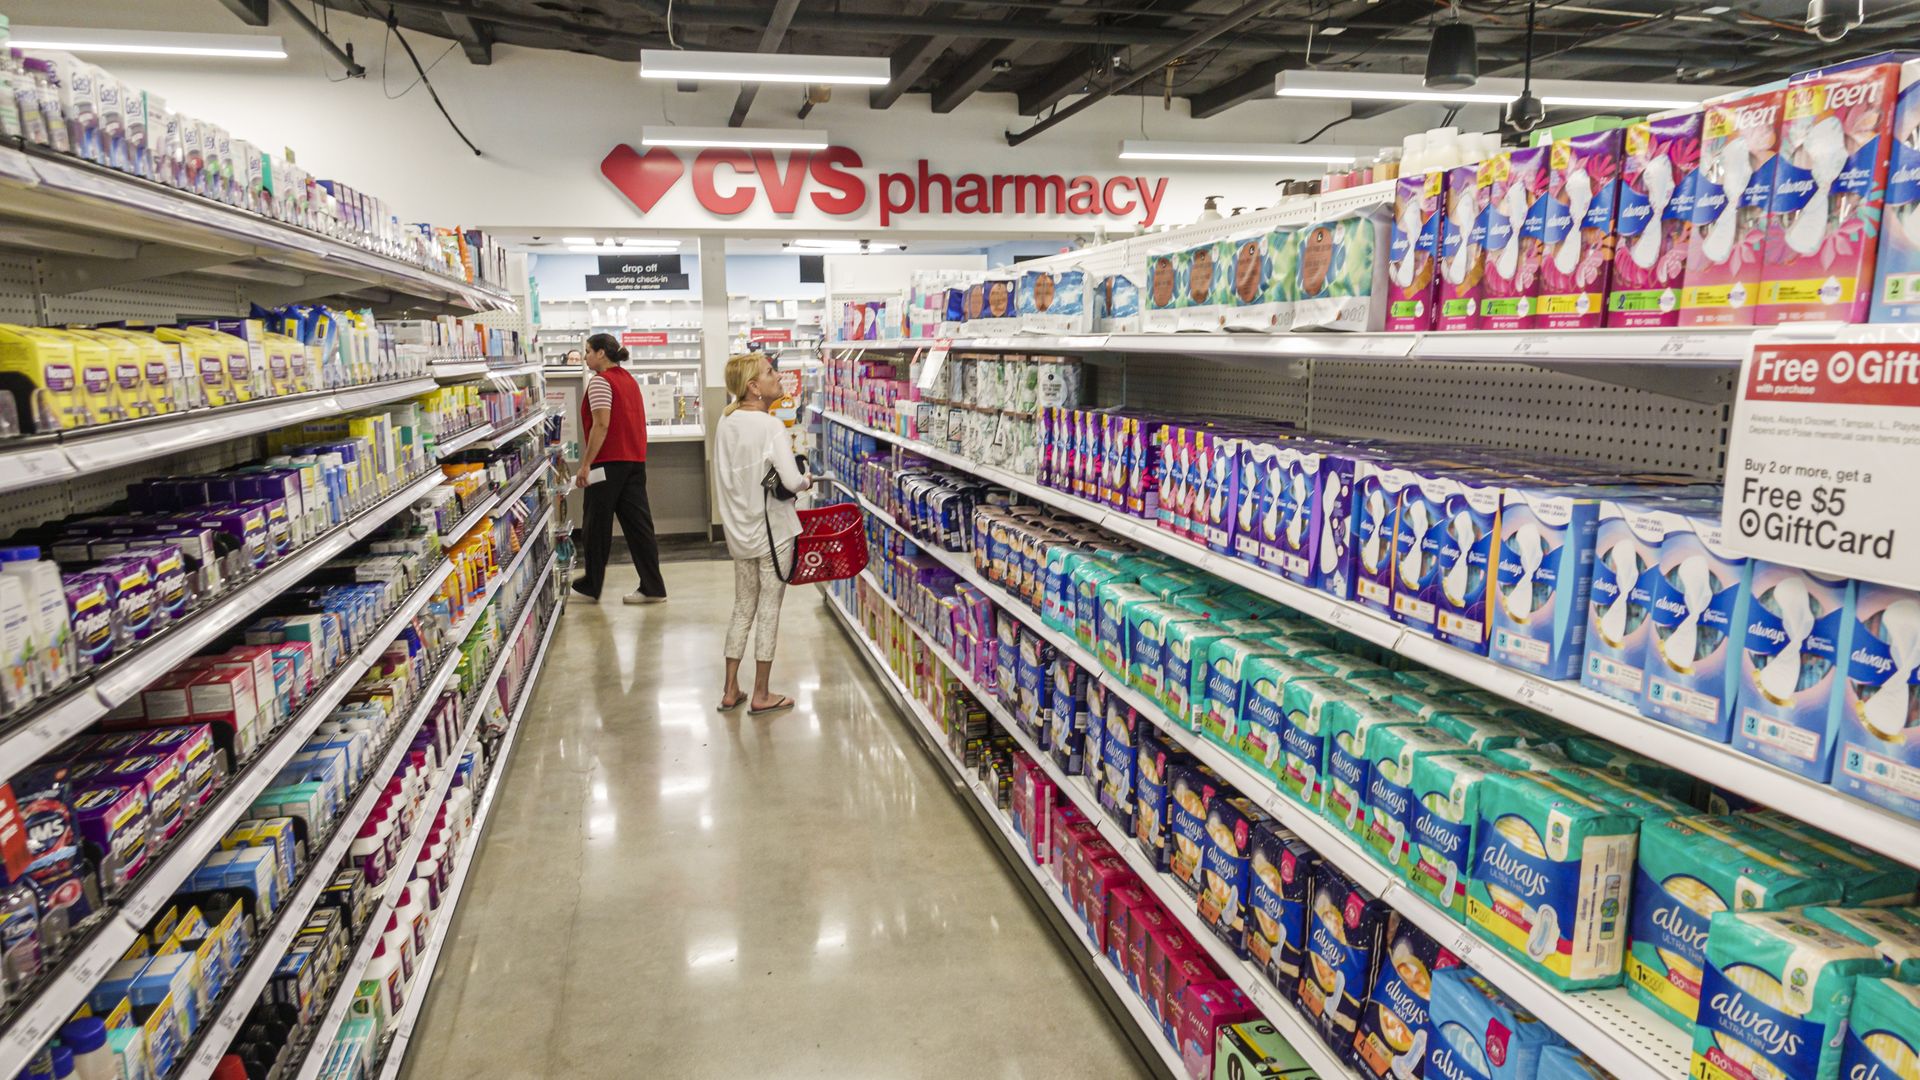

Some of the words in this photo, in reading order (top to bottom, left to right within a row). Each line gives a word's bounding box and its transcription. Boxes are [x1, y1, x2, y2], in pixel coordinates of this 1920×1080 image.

[1823, 80, 1882, 111] Teen
[1734, 104, 1778, 131] Teen
[692, 146, 867, 215] CVS
[880, 159, 1169, 227] pharmacy
[1696, 192, 1725, 209] always
[1777, 178, 1814, 199] always
[1622, 203, 1651, 221] always
[606, 275, 635, 284] vaccine
[636, 274, 668, 284] check-in
[621, 264, 644, 274] drop
[645, 263, 658, 273] off
[1891, 279, 1900, 295] 2
[1756, 351, 1820, 382] Free
[1756, 384, 1773, 393] with
[1774, 385, 1816, 396] purchase
[1744, 458, 1766, 474] Buy
[1769, 462, 1776, 473] 2
[1779, 464, 1793, 475] or
[1795, 464, 1832, 480] more,
[1836, 467, 1859, 483] get
[1863, 472, 1872, 483] a
[1742, 477, 1802, 511] Free
[1811, 485, 1846, 517] $5
[1764, 511, 1896, 560] GiftCard
[1441, 544, 1460, 561] always
[1499, 558, 1523, 577] always
[1594, 577, 1618, 596] always
[1655, 597, 1687, 618] always
[1748, 621, 1785, 645] always
[1851, 647, 1894, 674] always
[1209, 673, 1237, 704] always
[1653, 683, 1662, 696] 3
[1248, 696, 1281, 727] always
[1747, 717, 1756, 729] 3
[1105, 739, 1131, 770] always
[1283, 727, 1318, 760] always
[1331, 749, 1362, 784] always
[1850, 753, 1860, 768] 3
[1371, 779, 1409, 815] always
[1176, 809, 1204, 841] always
[1416, 813, 1462, 853] always
[1207, 845, 1236, 880] always
[1483, 843, 1550, 897] always
[1255, 884, 1280, 919] always
[1313, 927, 1340, 968] always
[1662, 933, 1687, 952] ULTRA
[1385, 979, 1427, 1025] always
[1393, 1004, 1409, 1021] MAXI
[1710, 992, 1805, 1057] always
[1718, 1017, 1745, 1038] ULTRA
[1746, 1032, 1766, 1051] THIN
